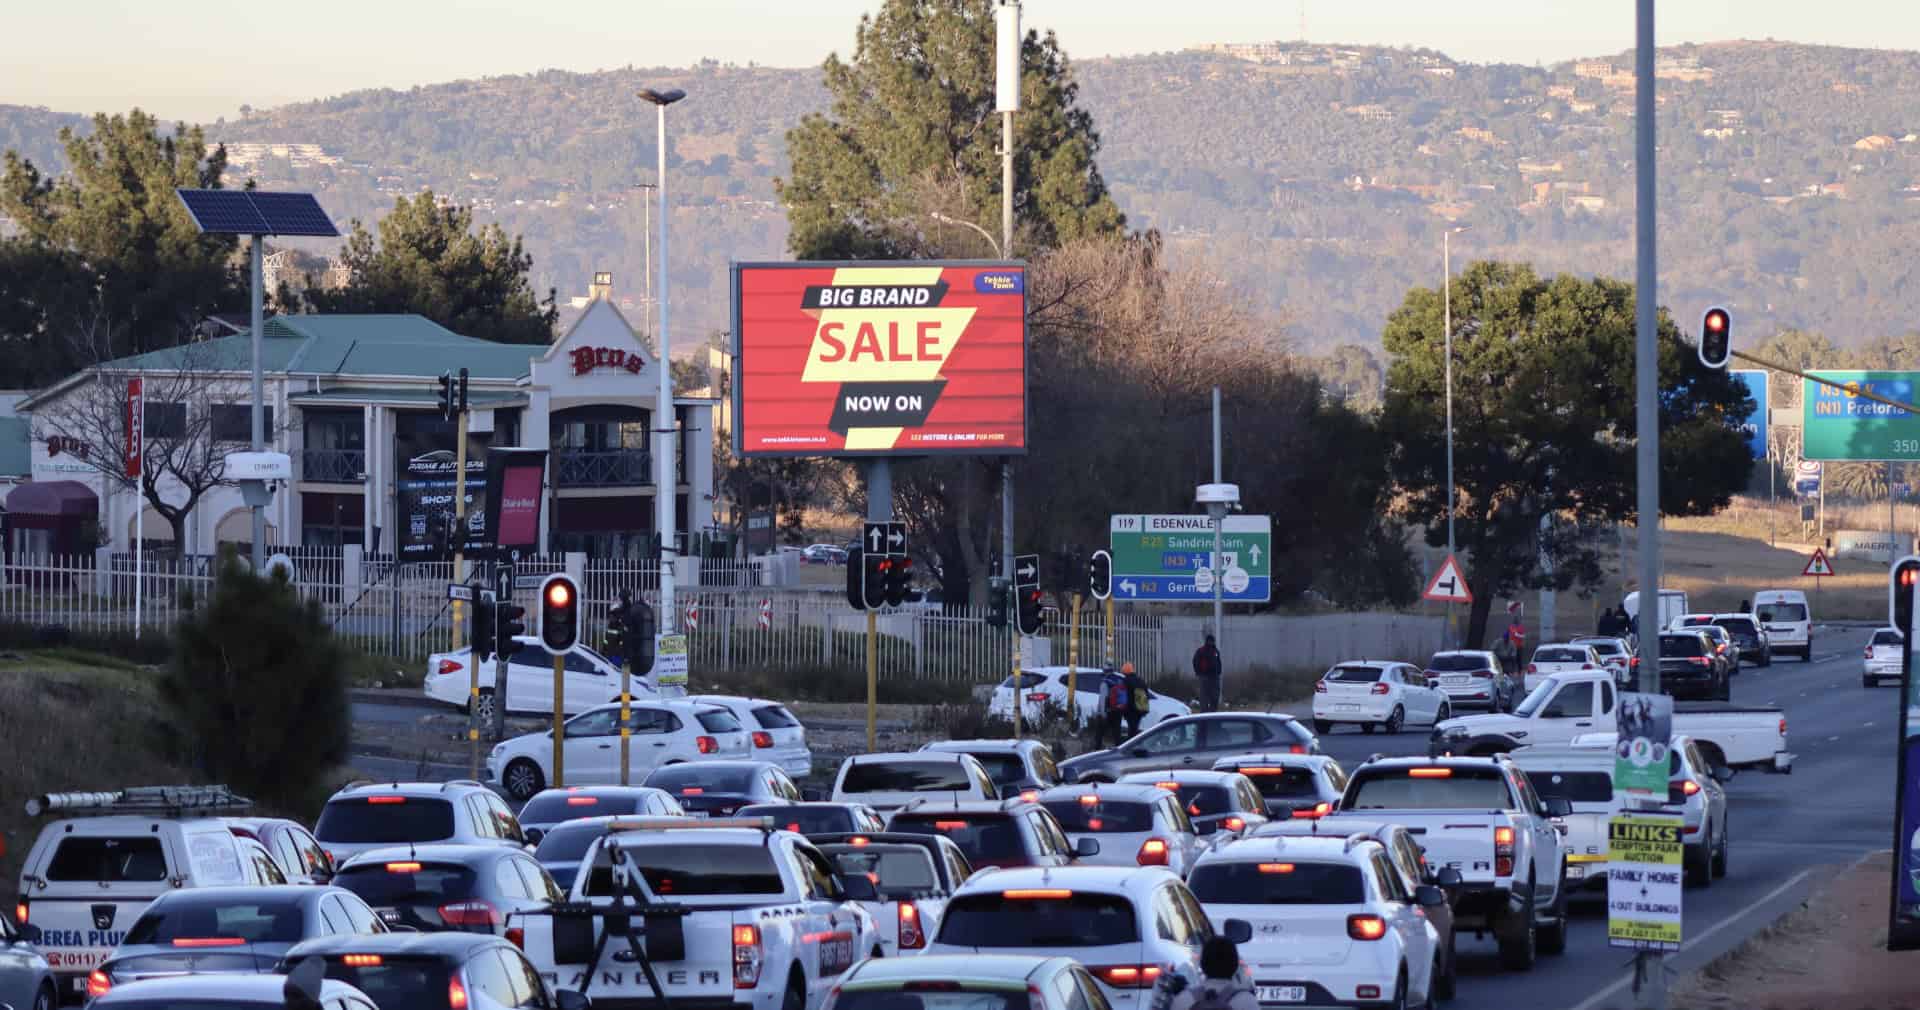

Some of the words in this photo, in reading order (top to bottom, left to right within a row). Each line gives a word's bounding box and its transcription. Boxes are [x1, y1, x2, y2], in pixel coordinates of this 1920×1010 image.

[819, 288, 854, 306] BIG
[859, 287, 930, 305] BRAND
[819, 321, 943, 362] SALE
[845, 396, 890, 412] NOW
[895, 395, 922, 411] ON
[1816, 401, 1841, 415] (N1)
[1847, 400, 1905, 415] Pretoria
[1118, 519, 1135, 529] 119
[1153, 518, 1215, 529] EDENVALE
[1612, 823, 1677, 842] LINKS
[1655, 842, 1680, 853] PARK
[1624, 852, 1664, 863] AUCTION
[1610, 868, 1643, 882] FAMILY
[1647, 871, 1680, 884] HOME
[1616, 902, 1633, 911] OUT
[1635, 903, 1680, 914] BUILDINGS
[63, 952, 96, 966] (011)
